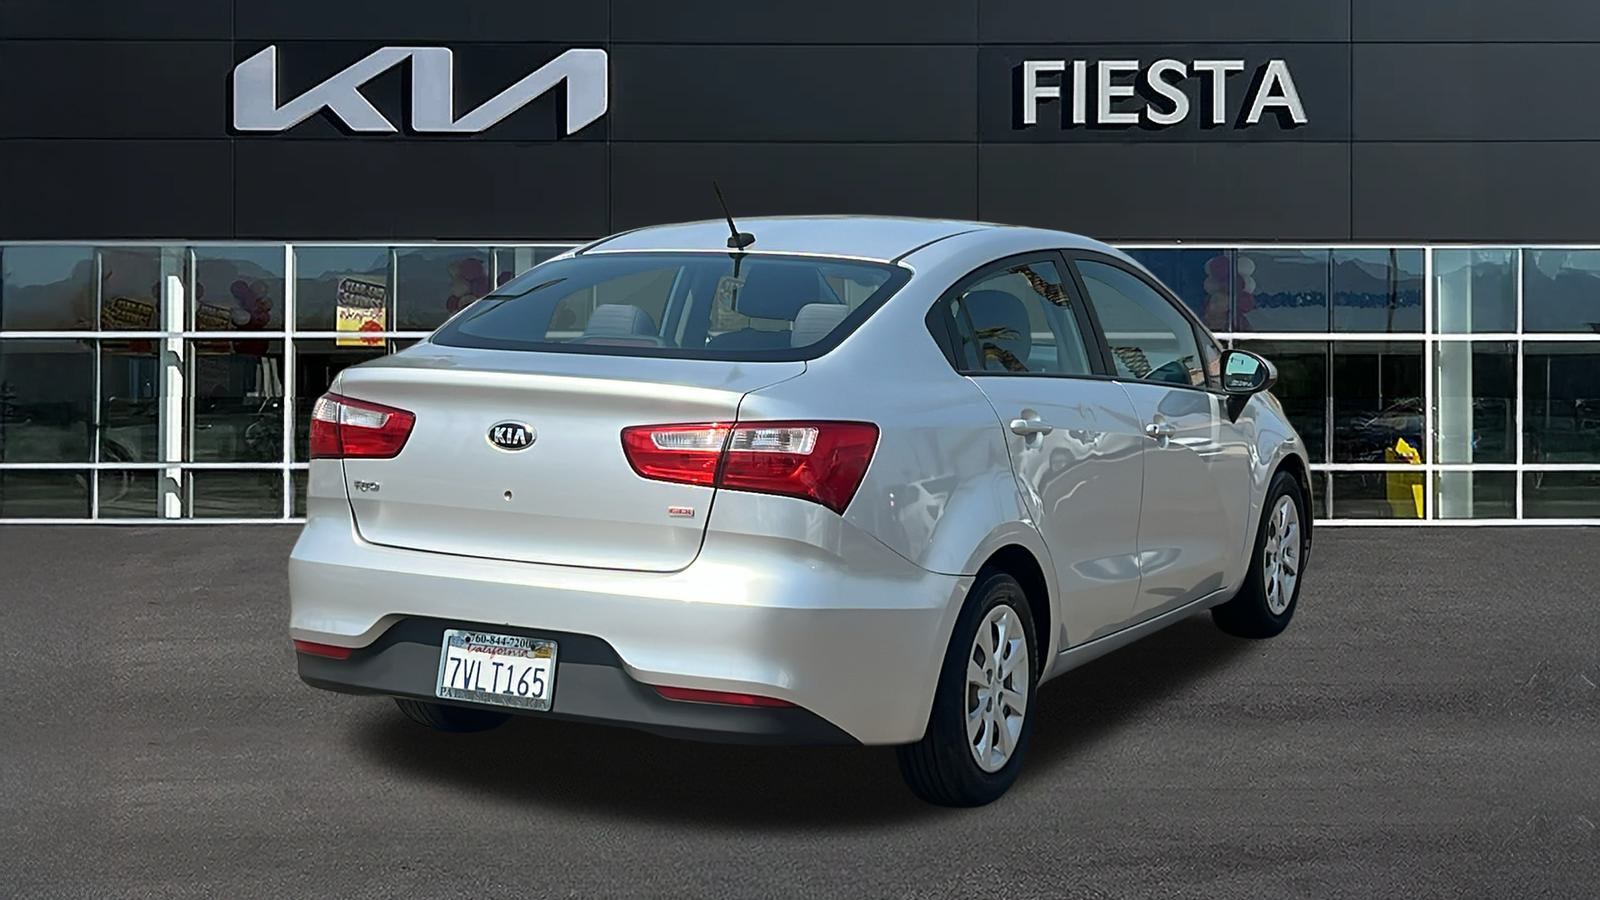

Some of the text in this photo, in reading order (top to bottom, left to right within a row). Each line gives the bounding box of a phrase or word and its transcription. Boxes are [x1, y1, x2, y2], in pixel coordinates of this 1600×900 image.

[233, 45, 608, 135] KIA
[1023, 59, 1308, 125] FIESTA
[494, 426, 527, 445] KIA
[467, 643, 529, 660] California
[449, 656, 545, 698] 7VLT165
